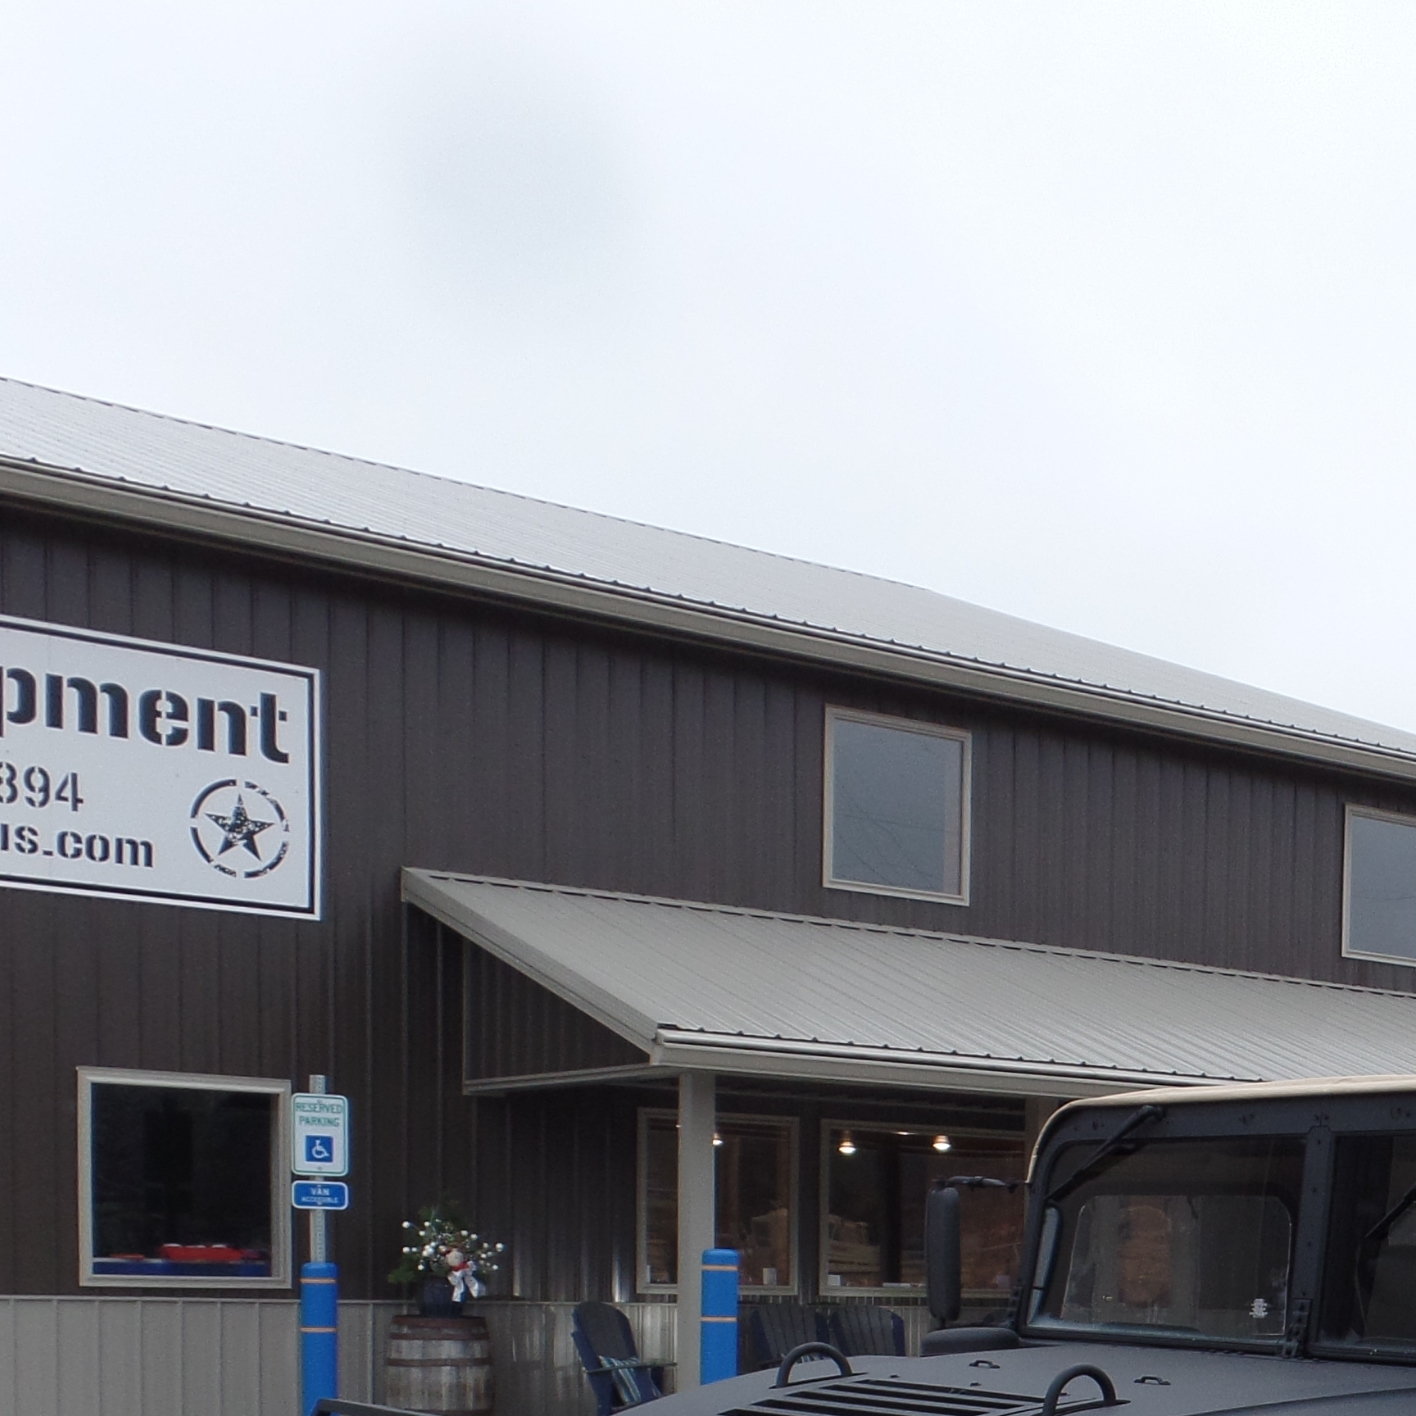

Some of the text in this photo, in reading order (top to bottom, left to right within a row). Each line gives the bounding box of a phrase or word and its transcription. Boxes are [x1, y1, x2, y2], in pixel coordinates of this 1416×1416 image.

[0, 666, 289, 764] pment
[295, 1102, 344, 1114] RESERVED
[299, 1115, 340, 1127] PARKING
[310, 1187, 330, 1196] VAN
